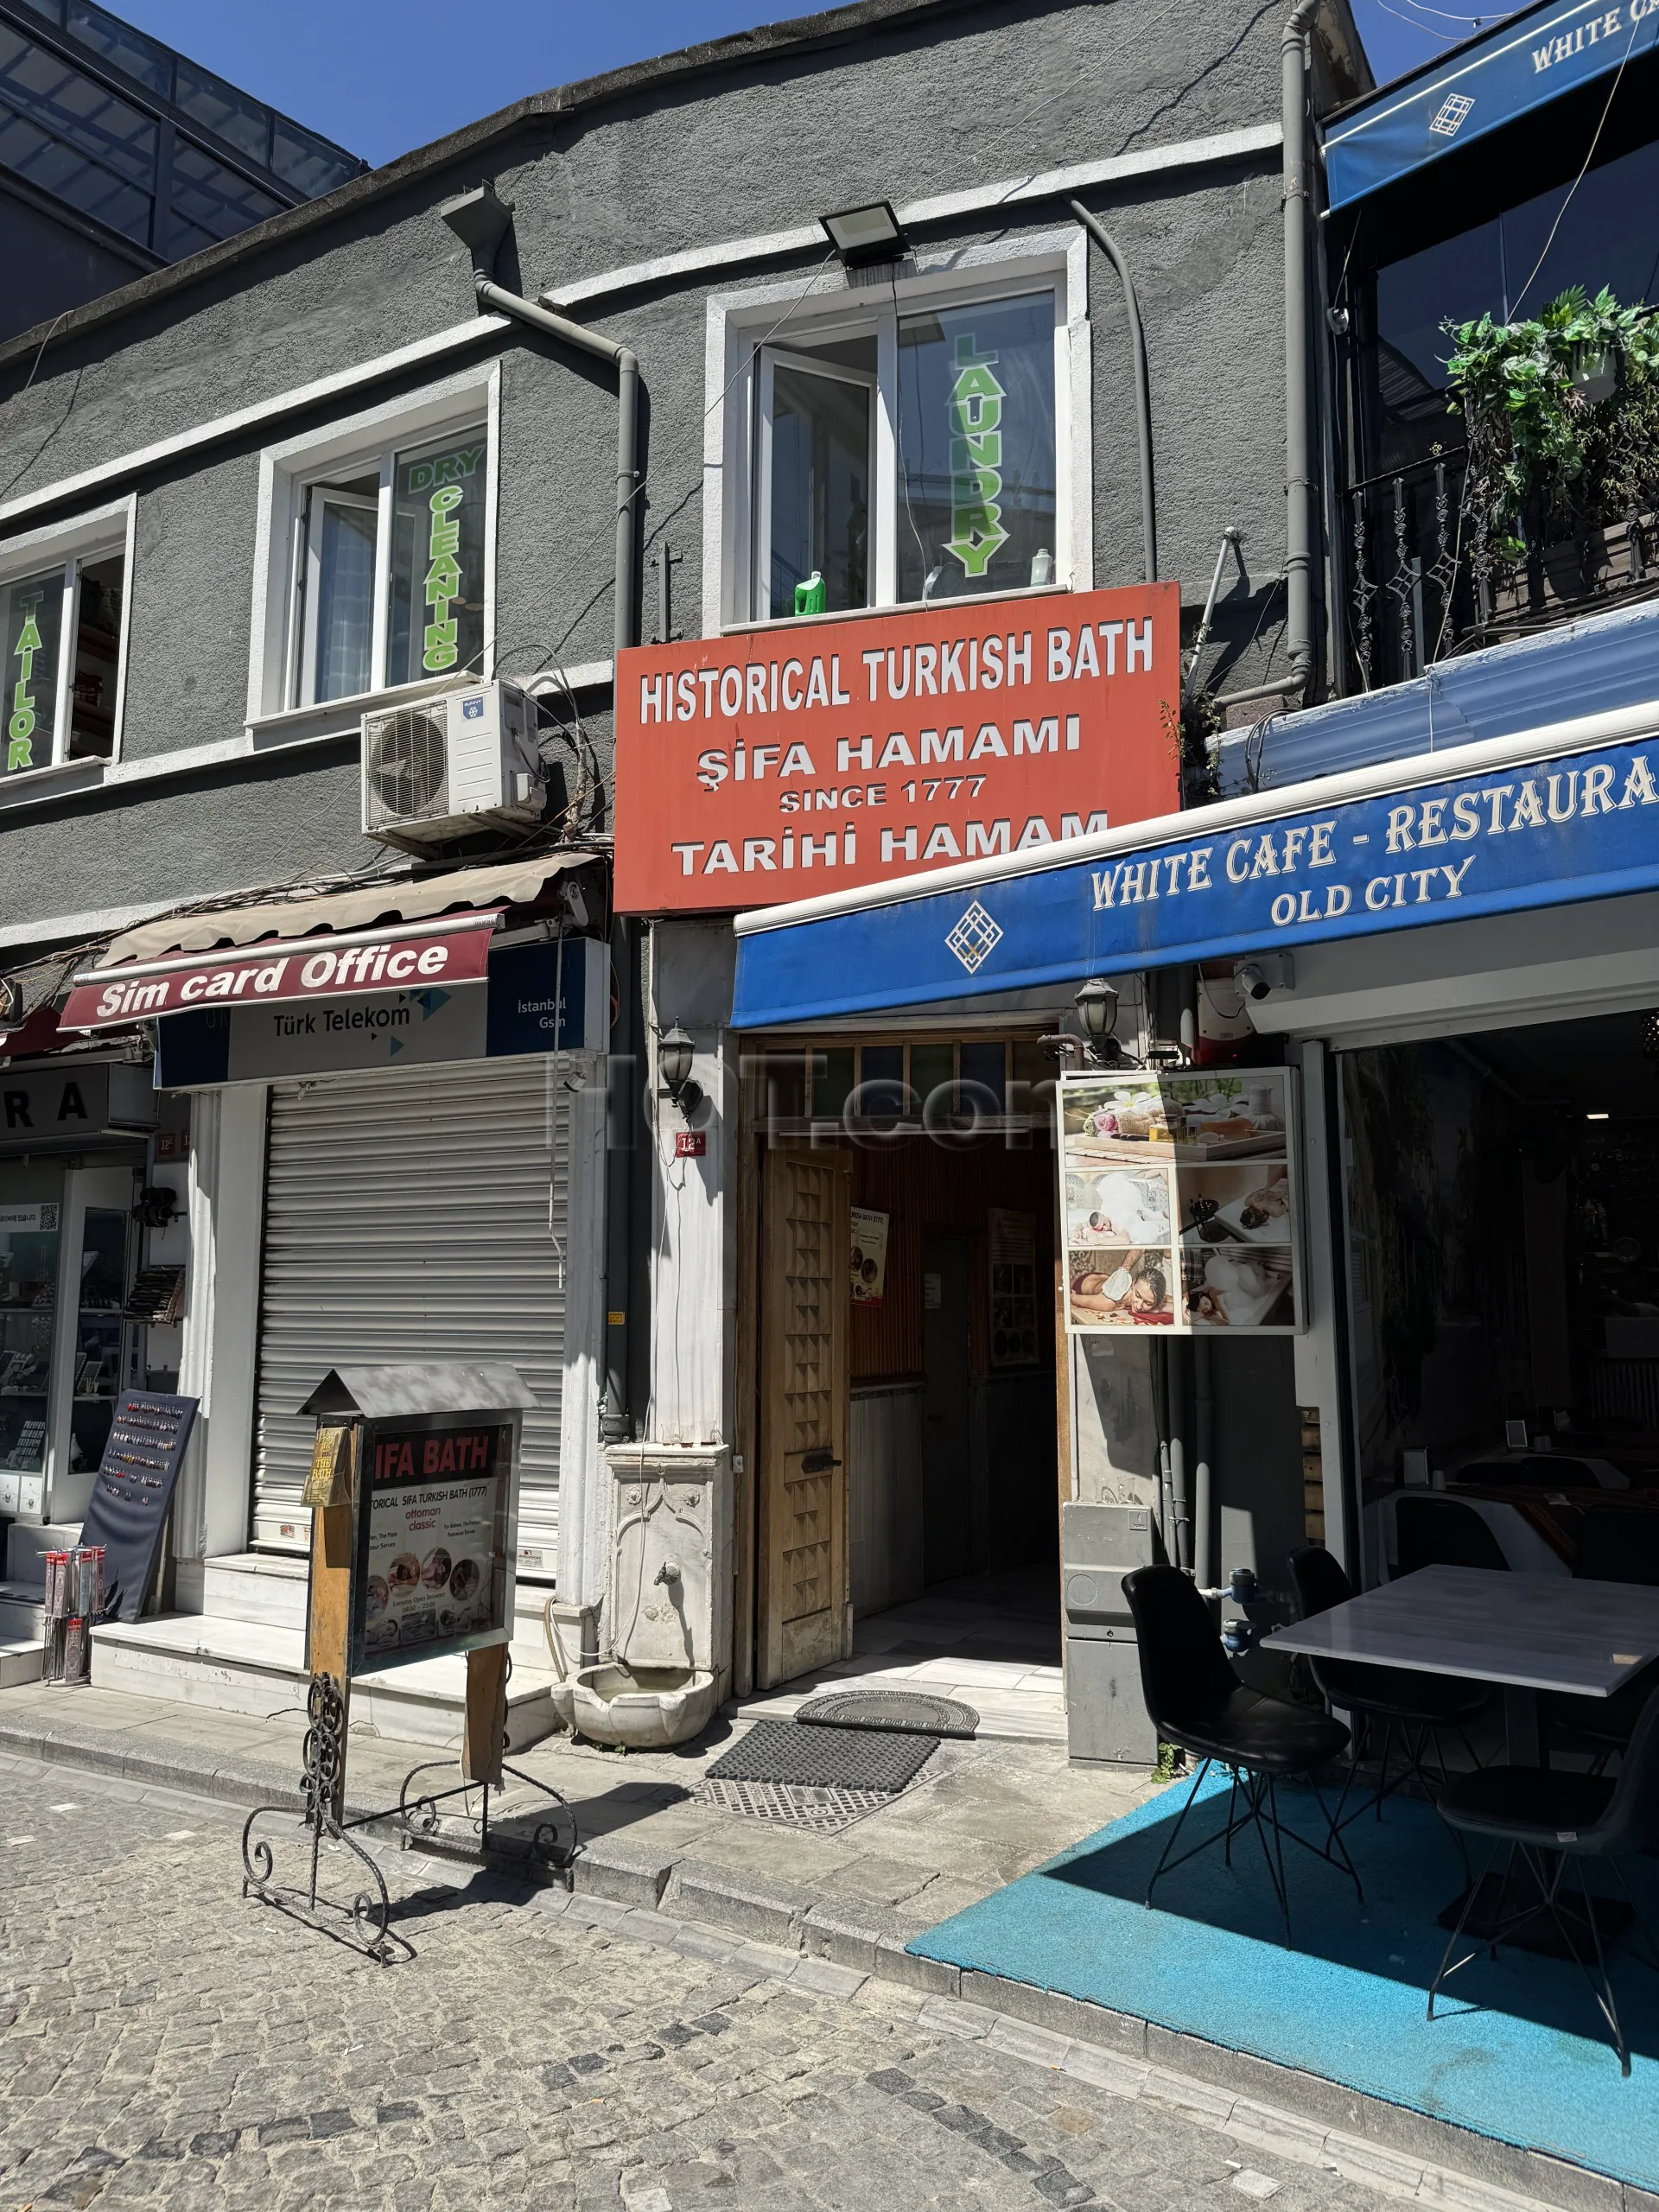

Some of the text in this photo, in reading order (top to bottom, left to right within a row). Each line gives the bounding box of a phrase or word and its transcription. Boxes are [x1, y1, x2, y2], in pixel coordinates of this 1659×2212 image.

[1532, 7, 1623, 73] WHITE
[409, 444, 486, 494] DRY
[942, 333, 1011, 578] LAUNDRY
[423, 485, 463, 671] CLEANING
[8, 590, 44, 771] TAILOR
[640, 616, 1153, 724] HISTORICAL TURKISH BATH
[696, 714, 1080, 791] ŞİFA HAMAMI
[780, 775, 986, 813] SINCE 1777
[671, 822, 855, 876] TARİHİ
[1091, 848, 1212, 912] WHITE
[1226, 822, 1337, 883] CAFE
[1385, 755, 1659, 855] RESTAURA
[1271, 855, 1476, 926] OLD CITY
[97, 944, 448, 1017] Sim card Office
[274, 1006, 410, 1036] Türk Telekom
[423, 1434, 489, 1474] BATH
[402, 1494, 417, 1506] SIFA
[419, 1491, 448, 1503] TURKISH
[449, 1488, 467, 1500] BATH
[468, 1486, 488, 1499] (1777)
[405, 1507, 441, 1519] ottoman
[409, 1517, 436, 1531] classic
